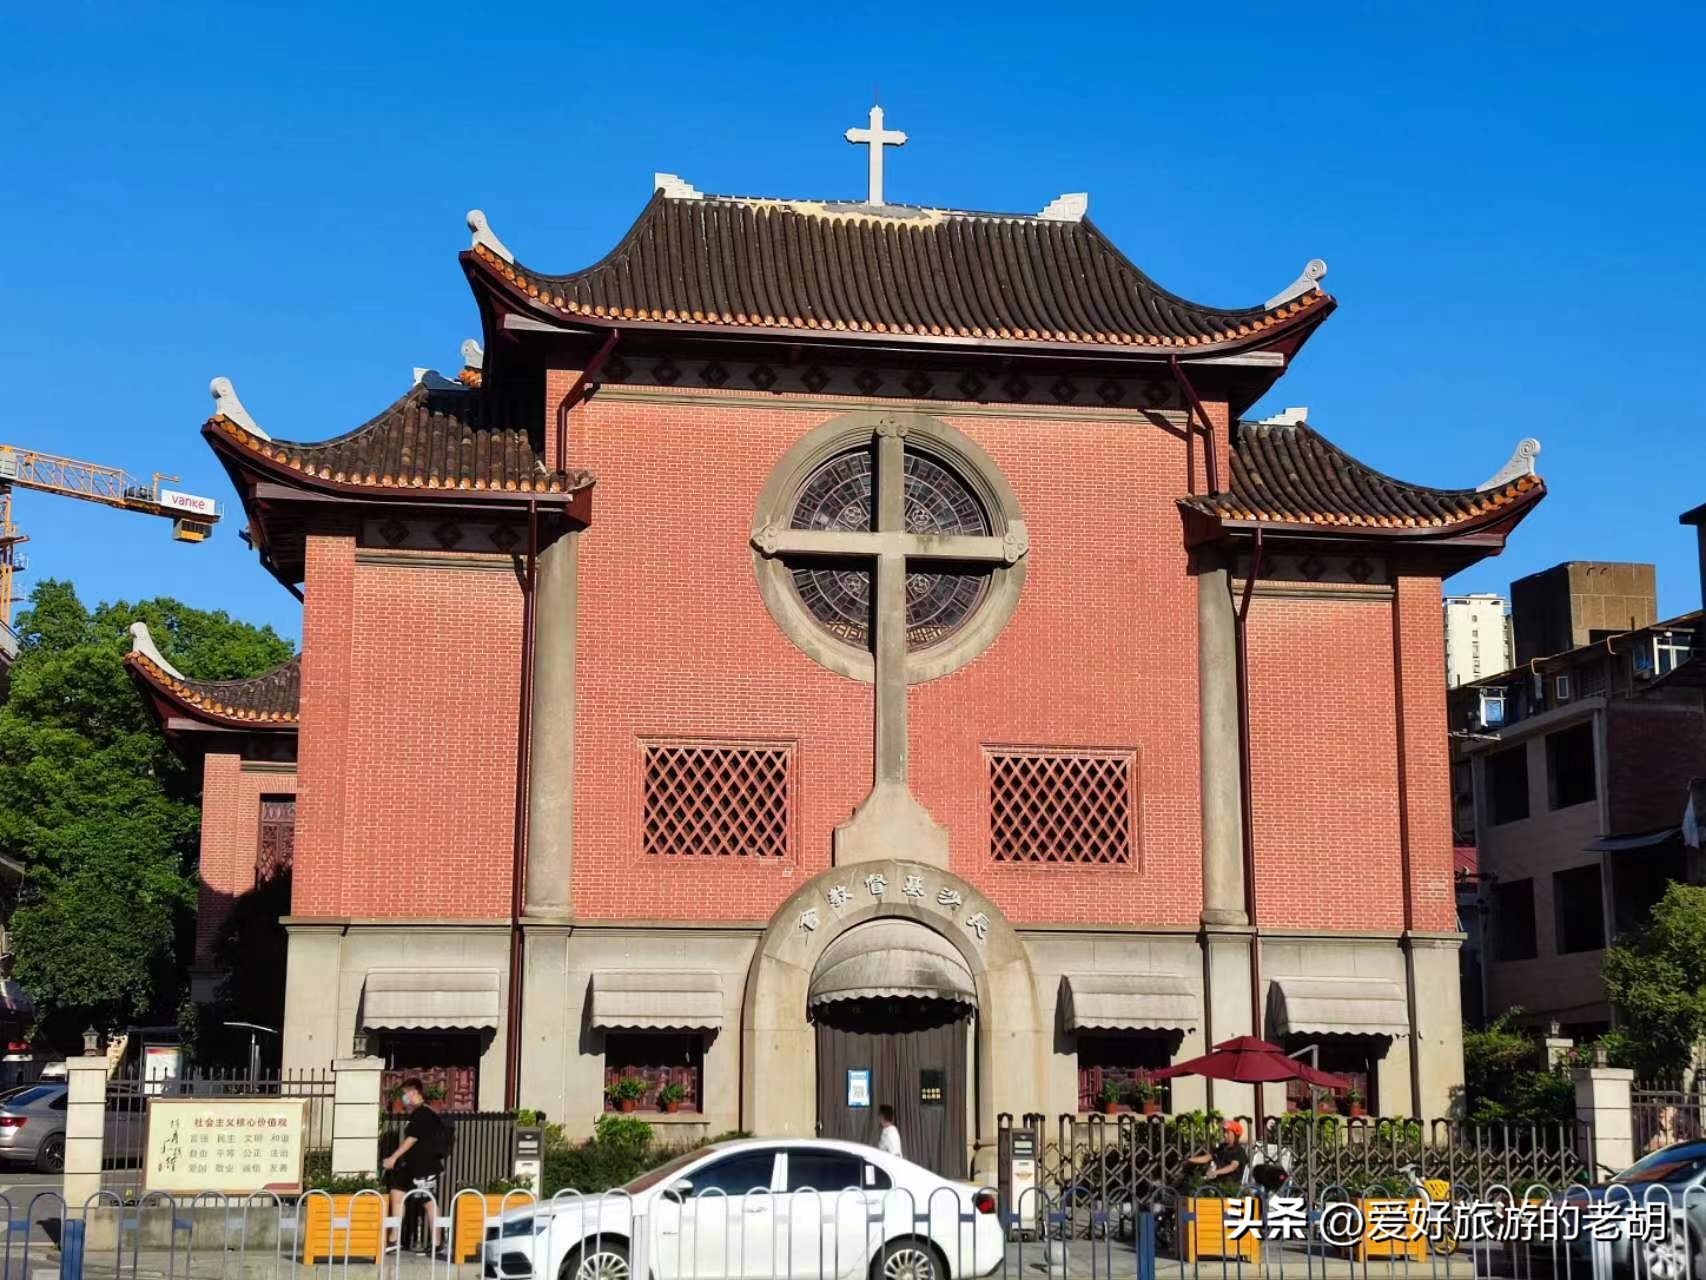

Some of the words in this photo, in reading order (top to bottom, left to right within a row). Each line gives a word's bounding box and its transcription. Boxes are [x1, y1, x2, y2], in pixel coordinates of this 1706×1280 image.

[172, 494, 206, 510] vanke
[194, 1117, 288, 1128] 社会主义核心价值观
[217, 1134, 236, 1144] 民主
[244, 1134, 263, 1144] 文明
